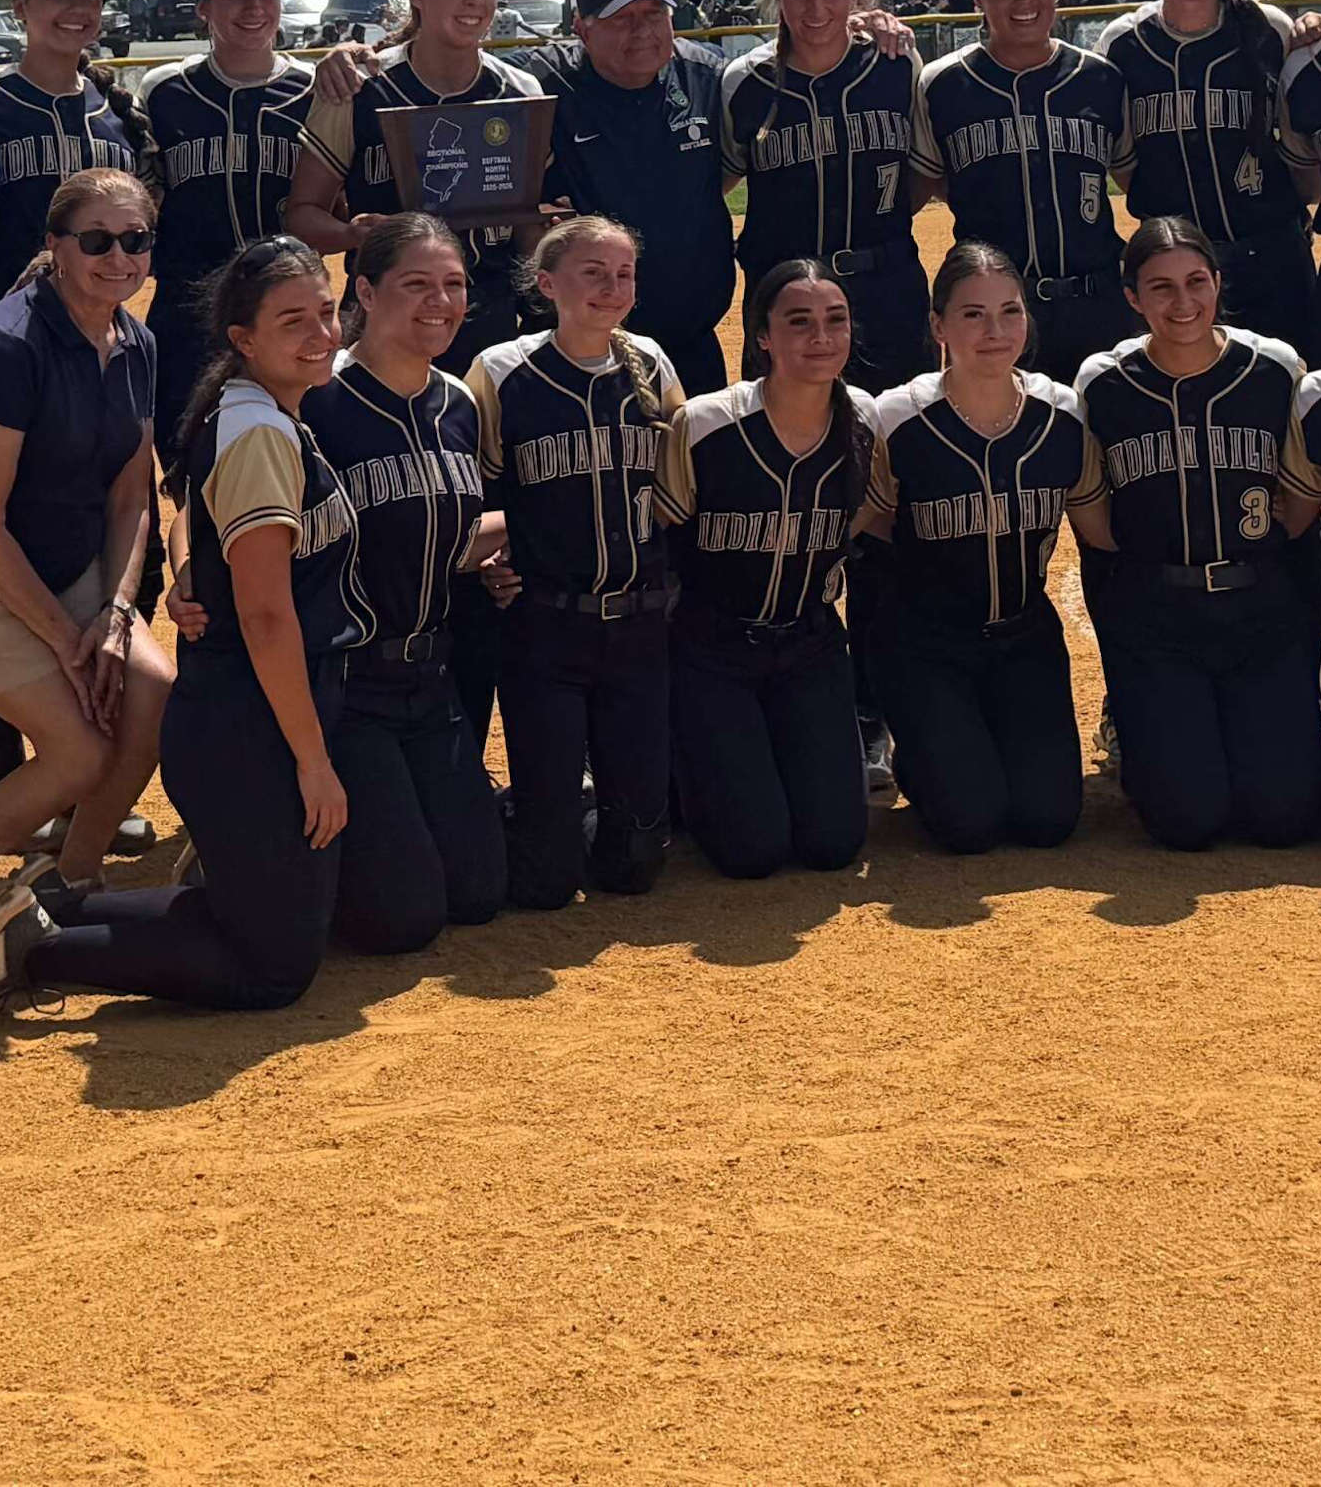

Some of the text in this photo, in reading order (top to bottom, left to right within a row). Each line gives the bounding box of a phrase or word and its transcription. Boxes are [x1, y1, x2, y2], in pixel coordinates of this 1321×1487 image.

[876, 161, 900, 214] 7
[1234, 146, 1263, 196] 4
[1080, 172, 1101, 224] 5
[698, 510, 803, 555] INDIAN
[910, 491, 1011, 541] INDIAN
[1238, 486, 1271, 541] 3
